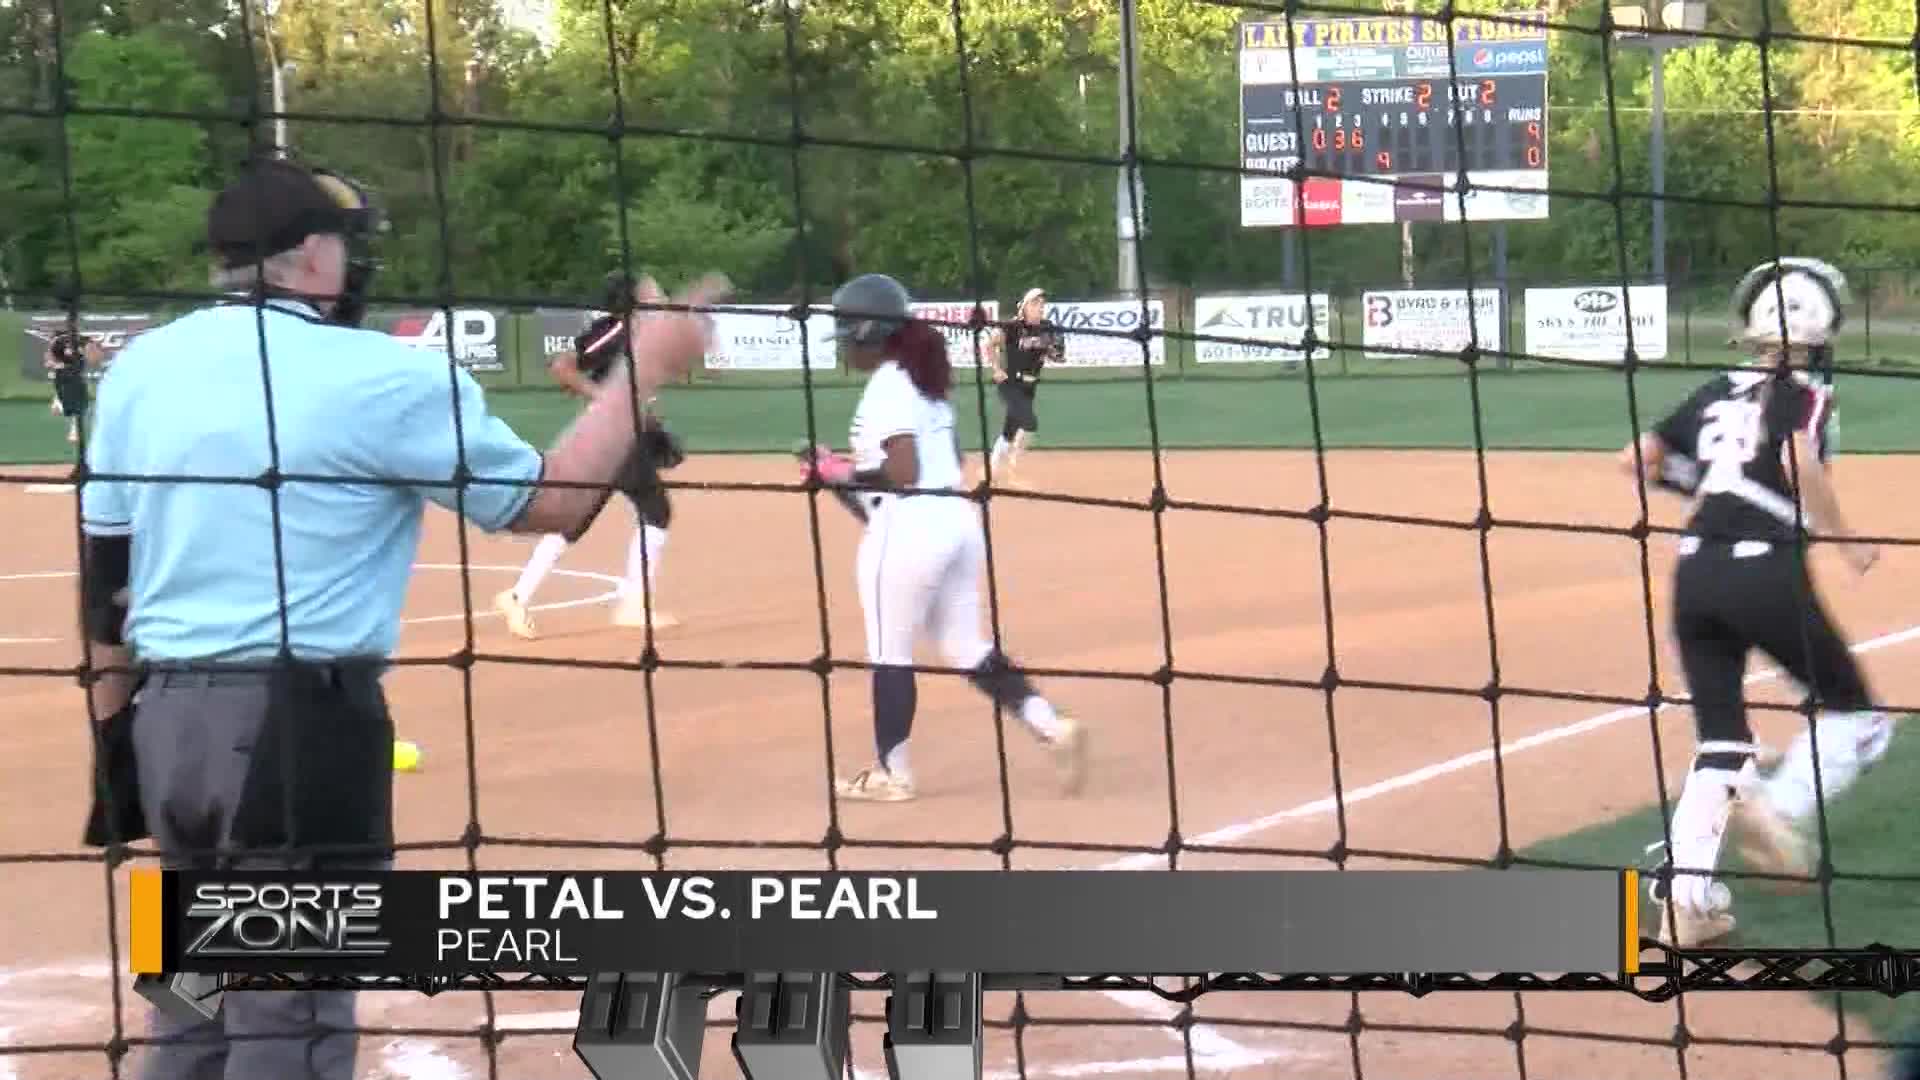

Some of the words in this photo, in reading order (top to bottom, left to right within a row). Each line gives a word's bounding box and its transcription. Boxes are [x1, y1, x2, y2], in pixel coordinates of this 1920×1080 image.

[1315, 20, 1413, 45] PIRATES
[1495, 49, 1544, 68] pepsi
[1325, 86, 1341, 112] 2
[1362, 85, 1414, 106] STRIKE
[1416, 80, 1432, 110] 2
[1479, 79, 1496, 107] 2
[1245, 131, 1297, 152] GUEST
[1247, 304, 1329, 328] TRUE
